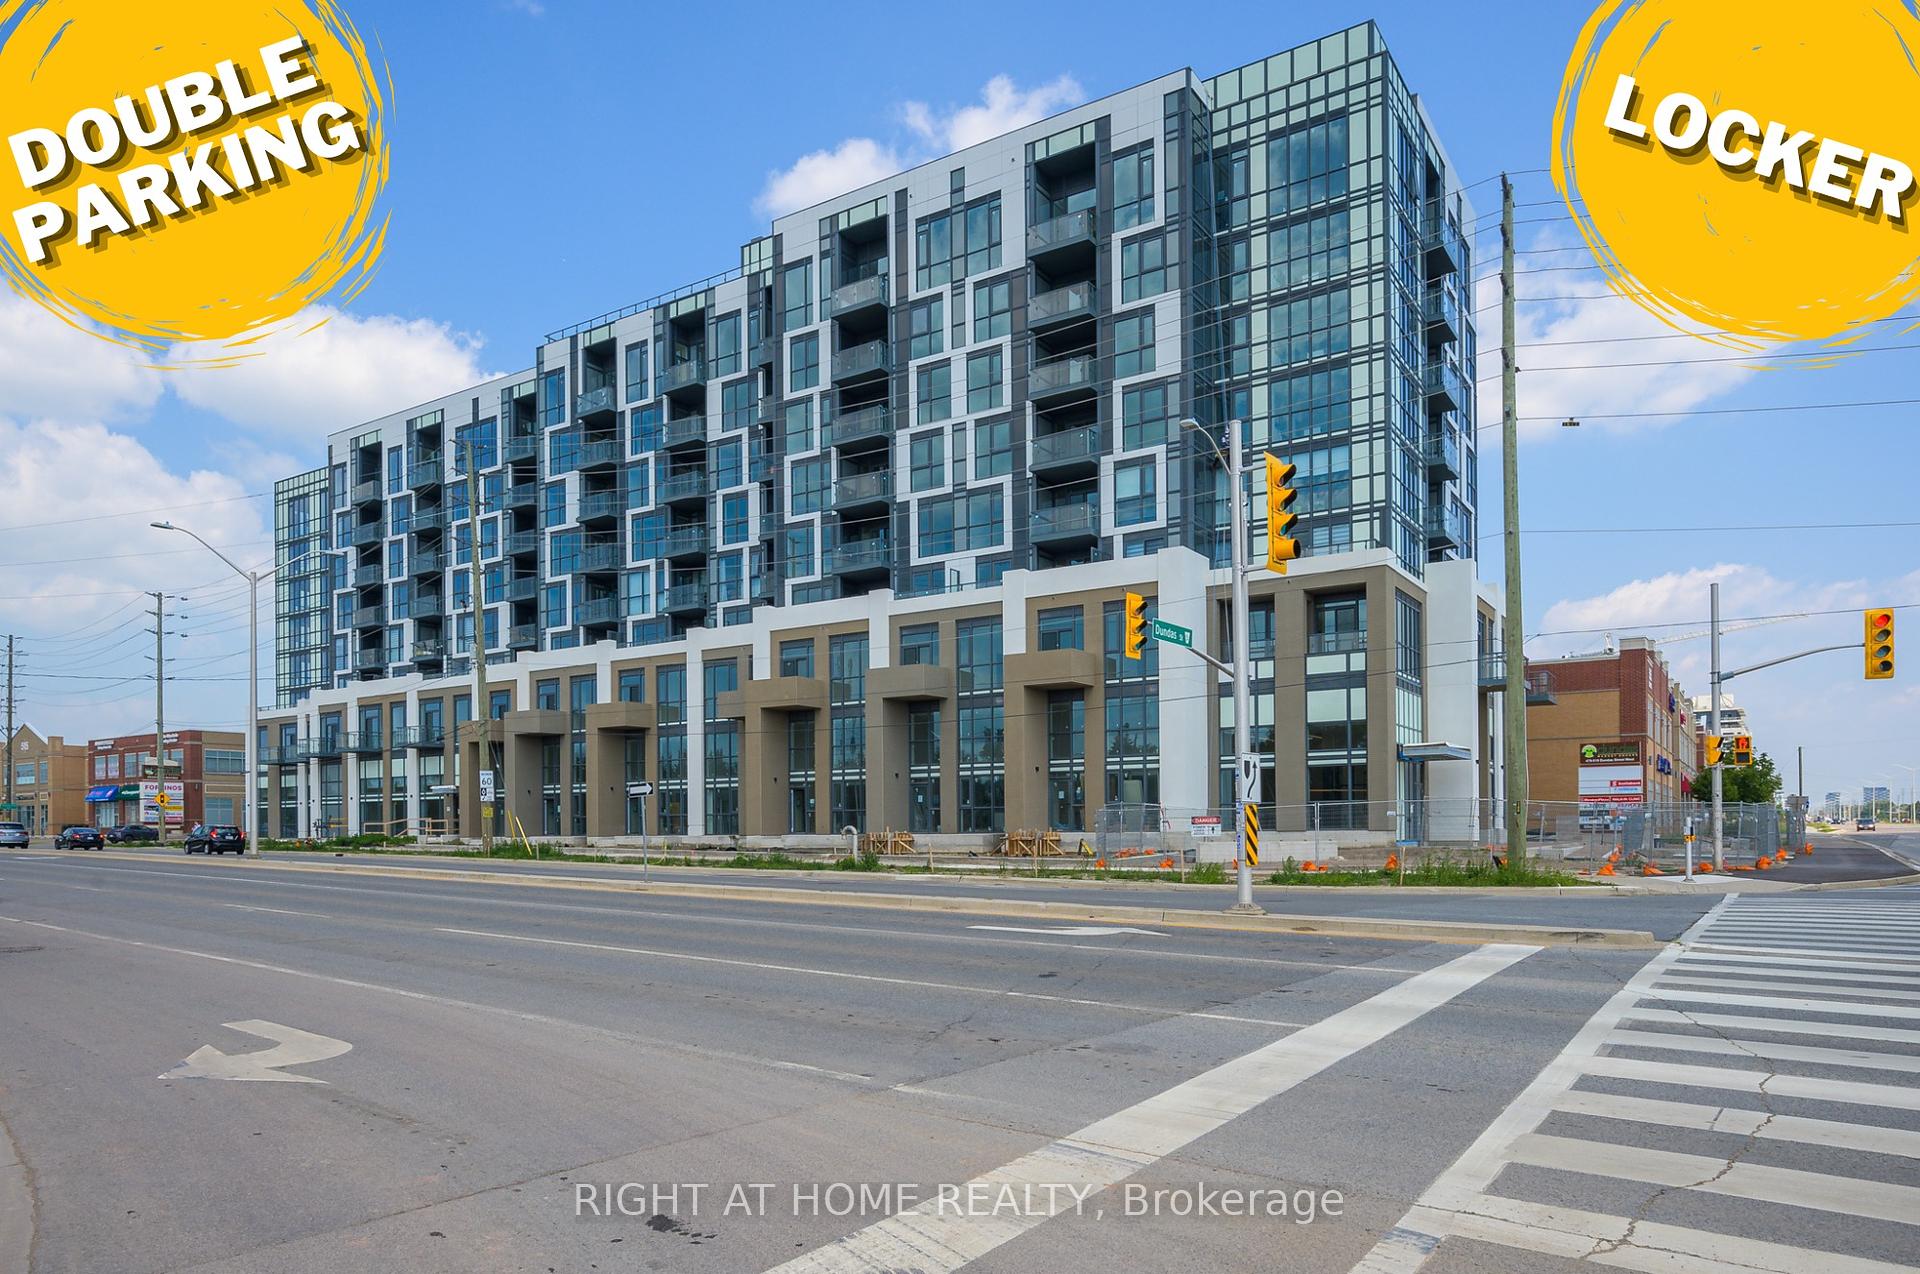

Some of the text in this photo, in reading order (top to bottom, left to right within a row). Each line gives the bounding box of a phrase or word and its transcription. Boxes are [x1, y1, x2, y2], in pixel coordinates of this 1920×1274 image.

[1155, 624, 1177, 640] Dundas
[482, 777, 492, 785] 60
[144, 784, 183, 792] FOINOS
